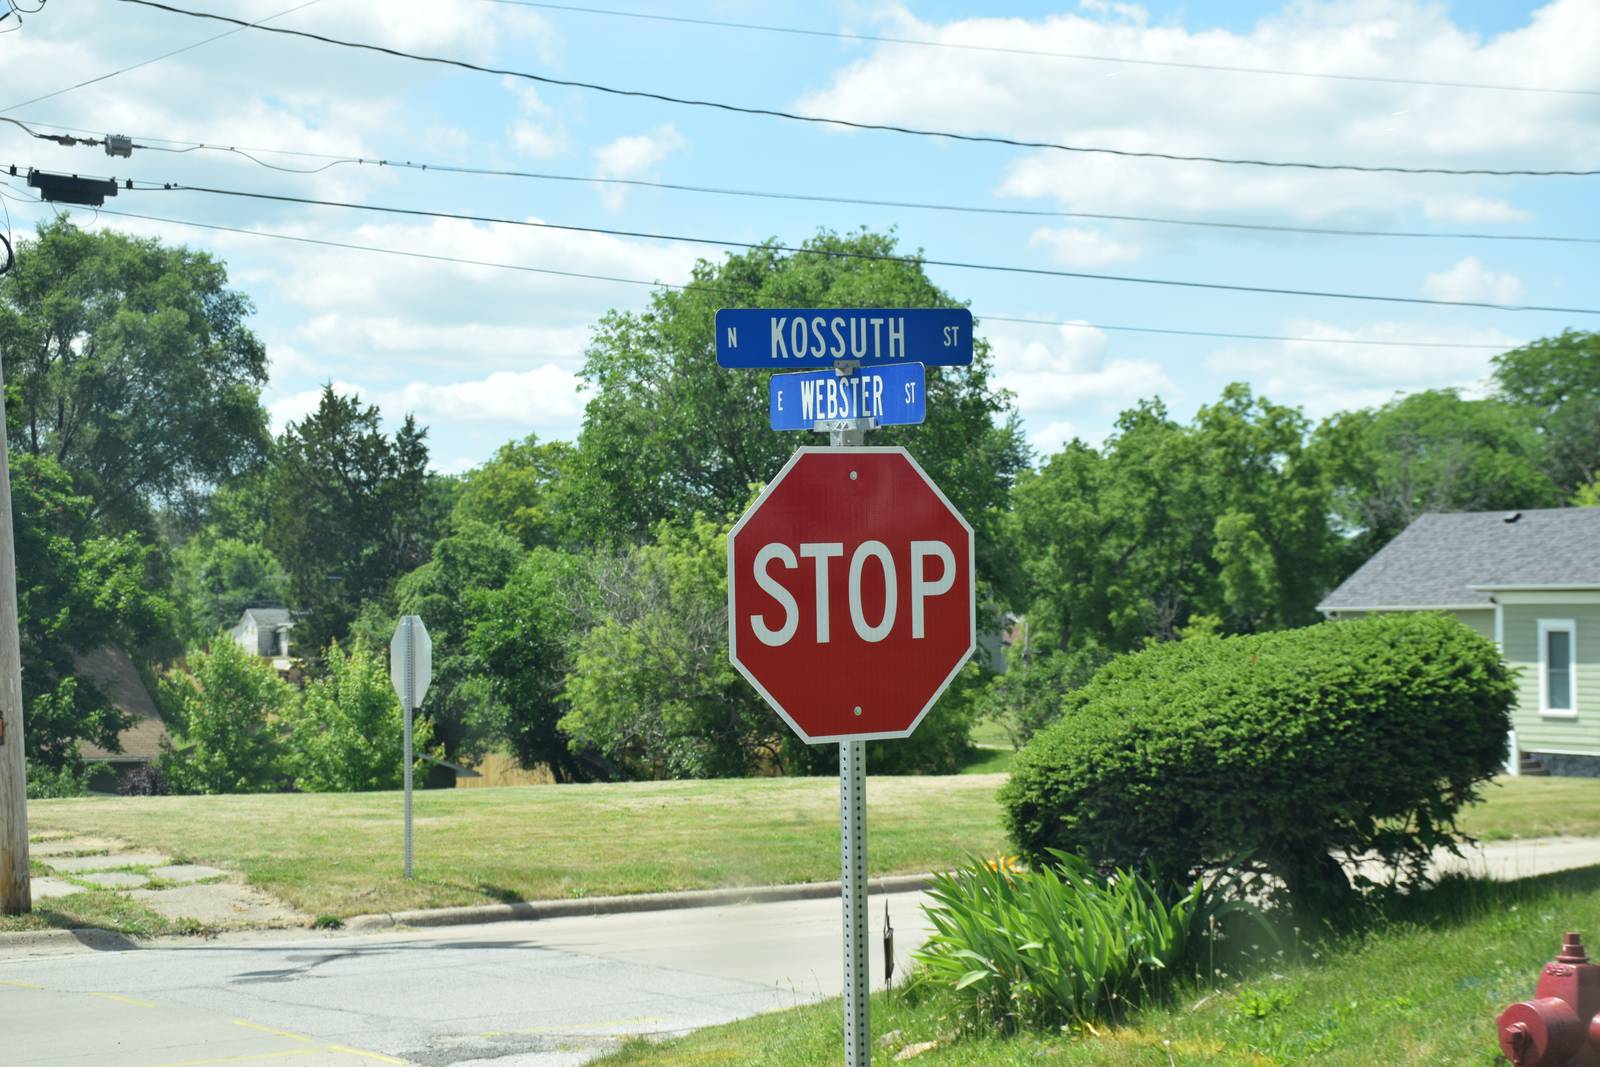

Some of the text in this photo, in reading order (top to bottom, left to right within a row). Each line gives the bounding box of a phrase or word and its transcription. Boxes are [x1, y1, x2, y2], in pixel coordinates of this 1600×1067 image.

[727, 316, 960, 359] N KOSSUTH ST
[777, 375, 916, 420] E WEBSTER ST
[750, 540, 957, 647] STOP
